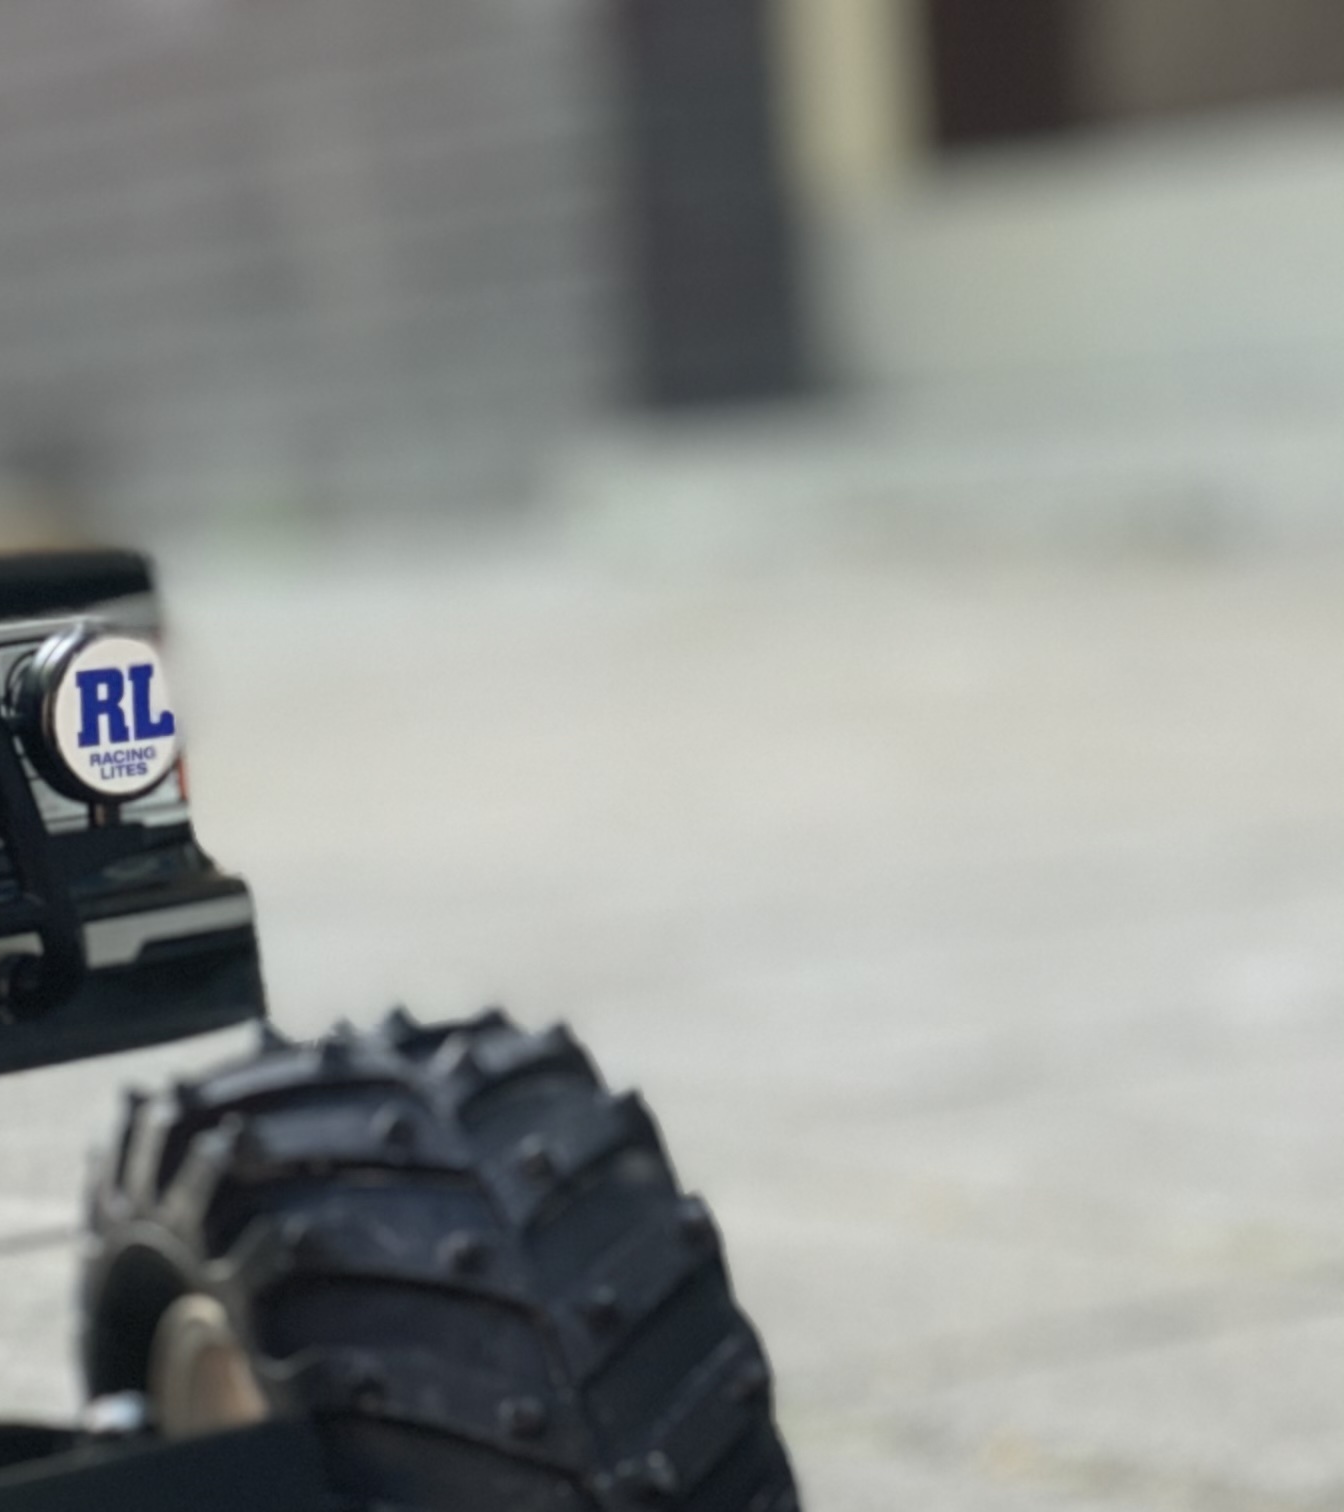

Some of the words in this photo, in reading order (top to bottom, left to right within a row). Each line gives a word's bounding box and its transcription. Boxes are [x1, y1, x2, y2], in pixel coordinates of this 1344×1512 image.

[76, 663, 175, 748] RL
[89, 746, 156, 767] RACING
[100, 763, 148, 780] LITES
